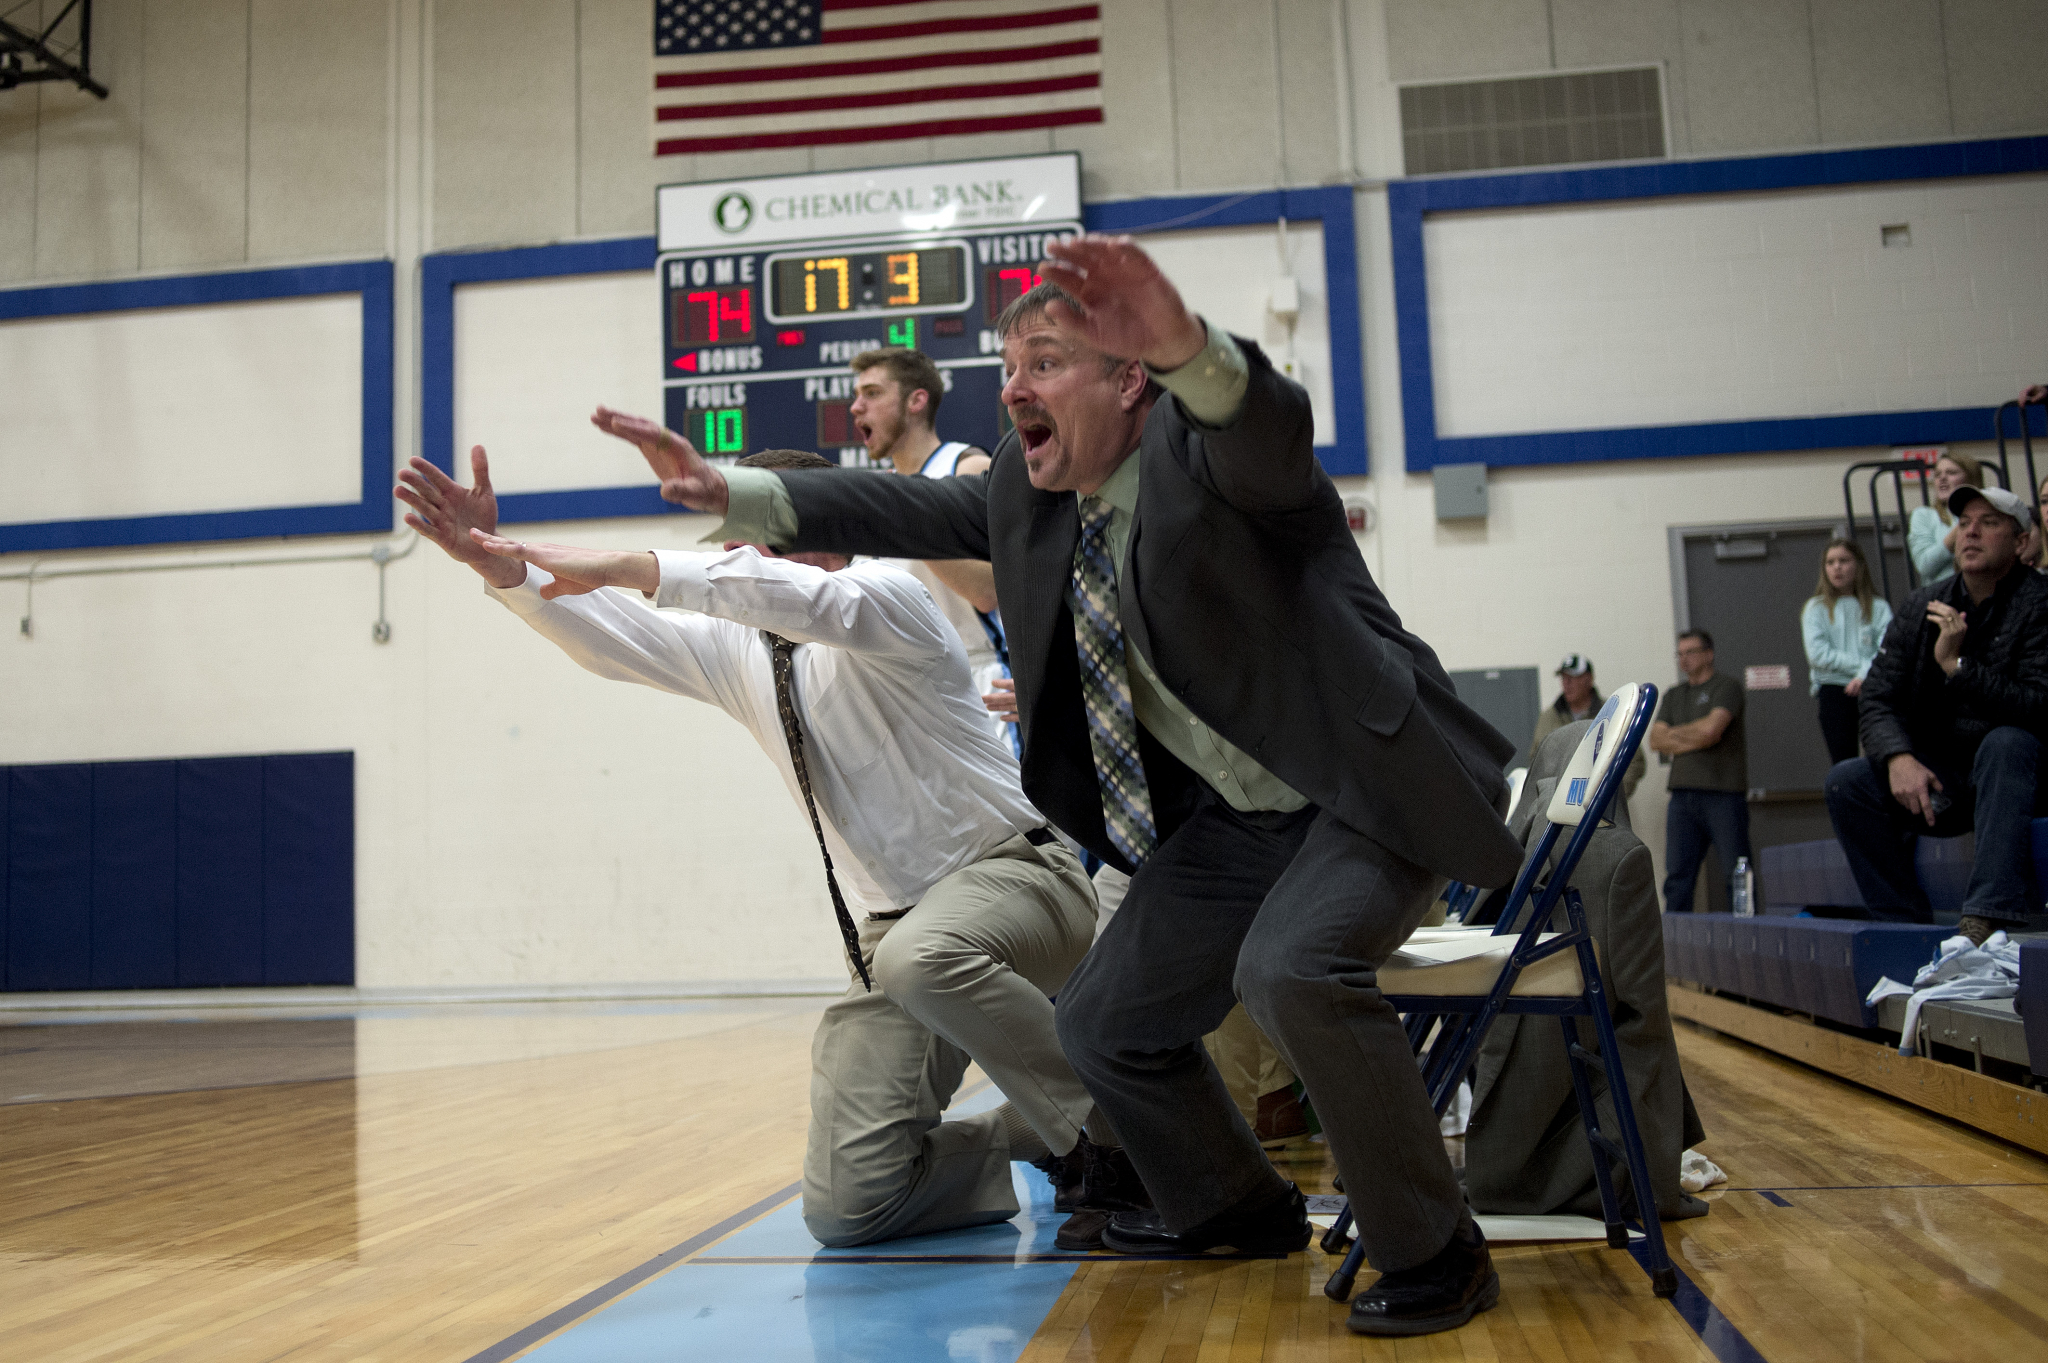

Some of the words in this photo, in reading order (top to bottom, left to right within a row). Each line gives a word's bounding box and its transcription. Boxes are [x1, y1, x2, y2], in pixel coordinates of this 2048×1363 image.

[764, 186, 924, 221] CHEMICAL
[669, 256, 756, 288] HOME
[687, 289, 751, 342] 74
[888, 317, 916, 349] 4
[698, 345, 763, 374] BONUS
[686, 383, 747, 409] FOULS
[704, 408, 743, 454] 10
